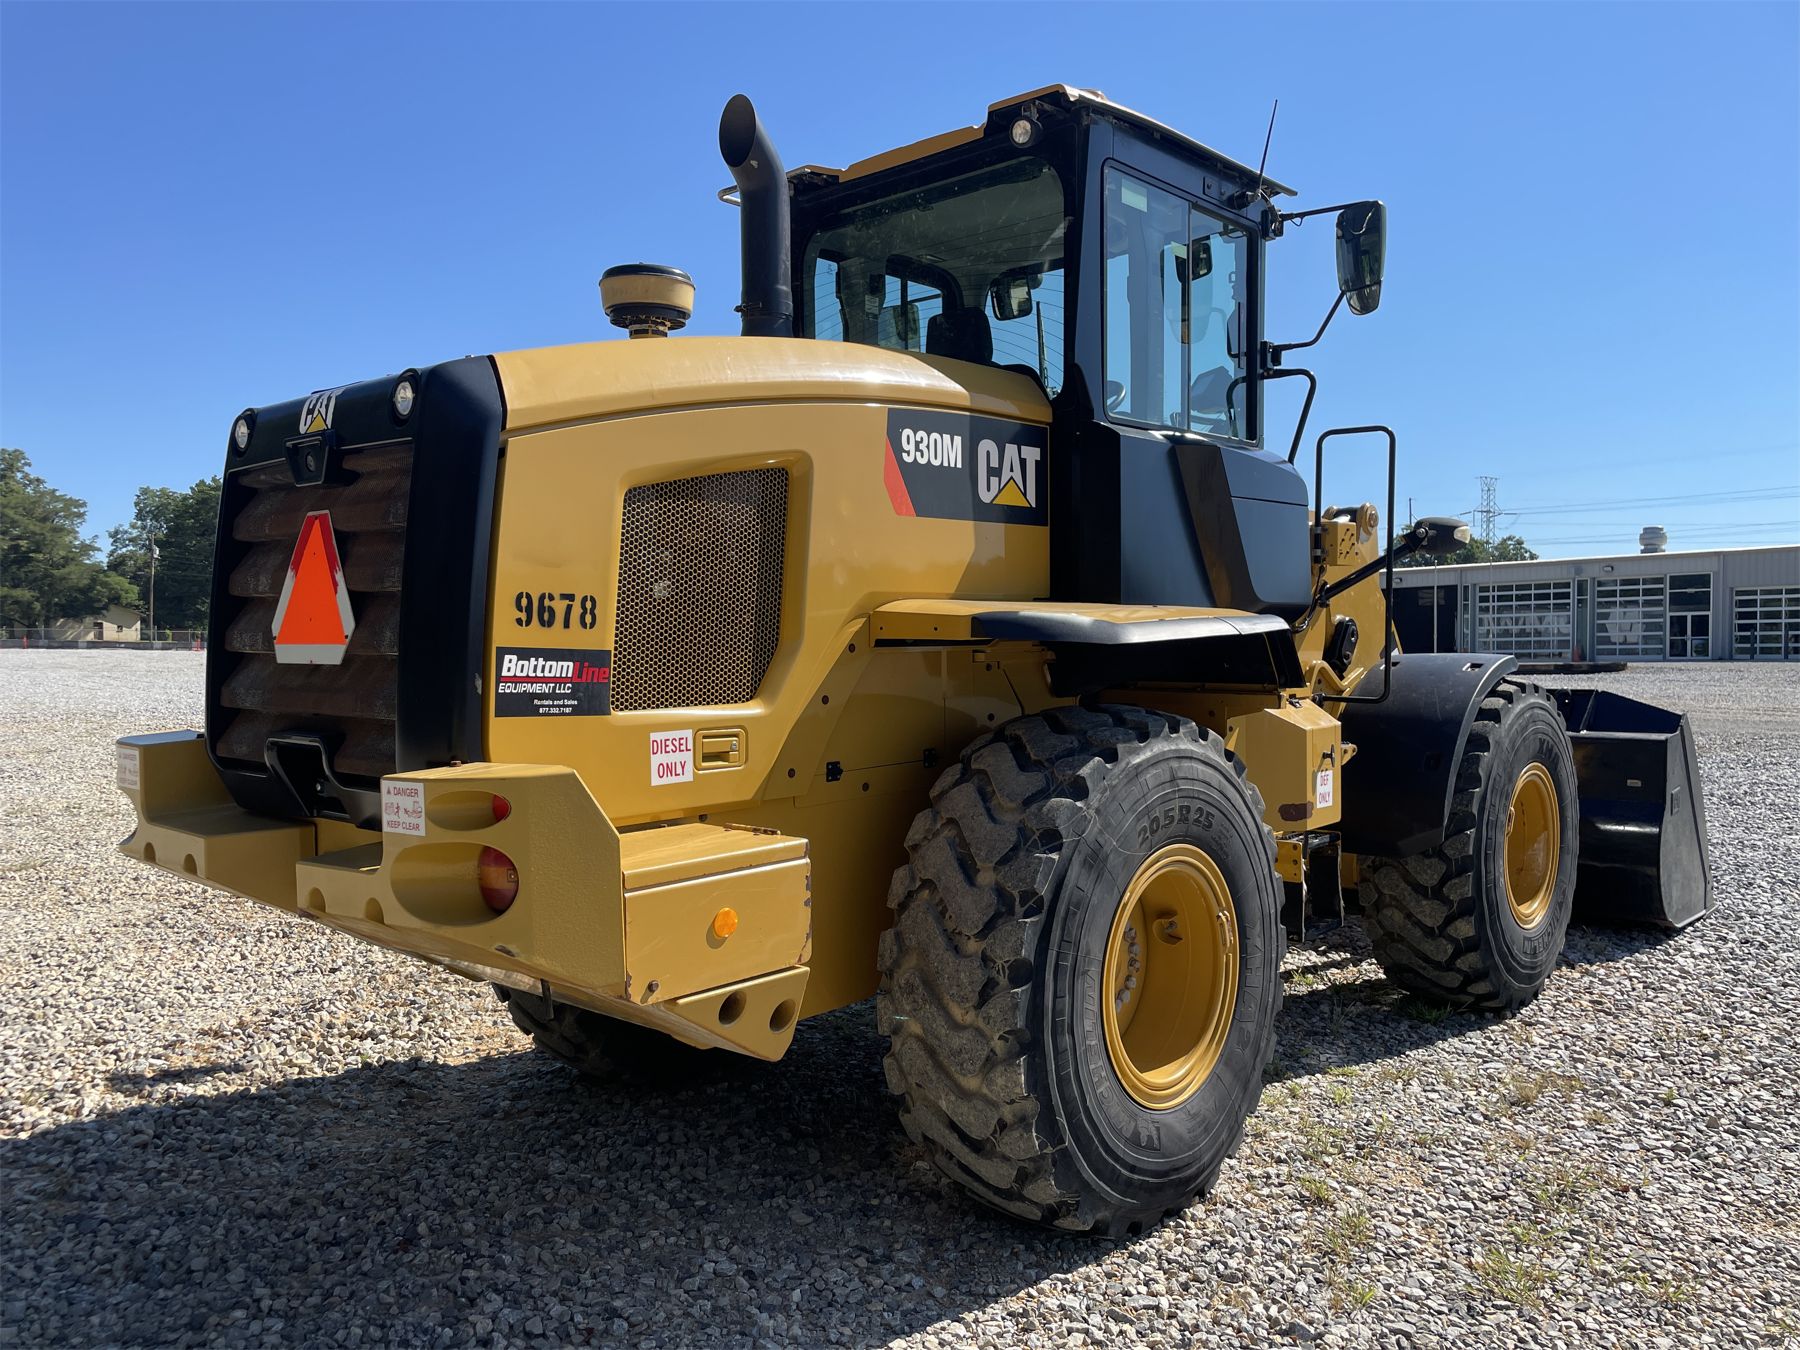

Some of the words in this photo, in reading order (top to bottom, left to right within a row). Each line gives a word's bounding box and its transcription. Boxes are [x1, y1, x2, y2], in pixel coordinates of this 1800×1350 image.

[299, 387, 345, 434] CAT
[901, 428, 962, 468] 930M
[977, 438, 1041, 508] CAT
[515, 591, 597, 630] 9678
[498, 683, 554, 694] EQUIPMENT
[555, 683, 573, 694] LLC
[651, 737, 692, 756] DIESEL
[657, 761, 687, 778] ONLY
[393, 786, 419, 798] DANGER
[1319, 792, 1331, 804] ONLY
[387, 820, 400, 829] KEEP
[402, 821, 421, 831] CLEAR
